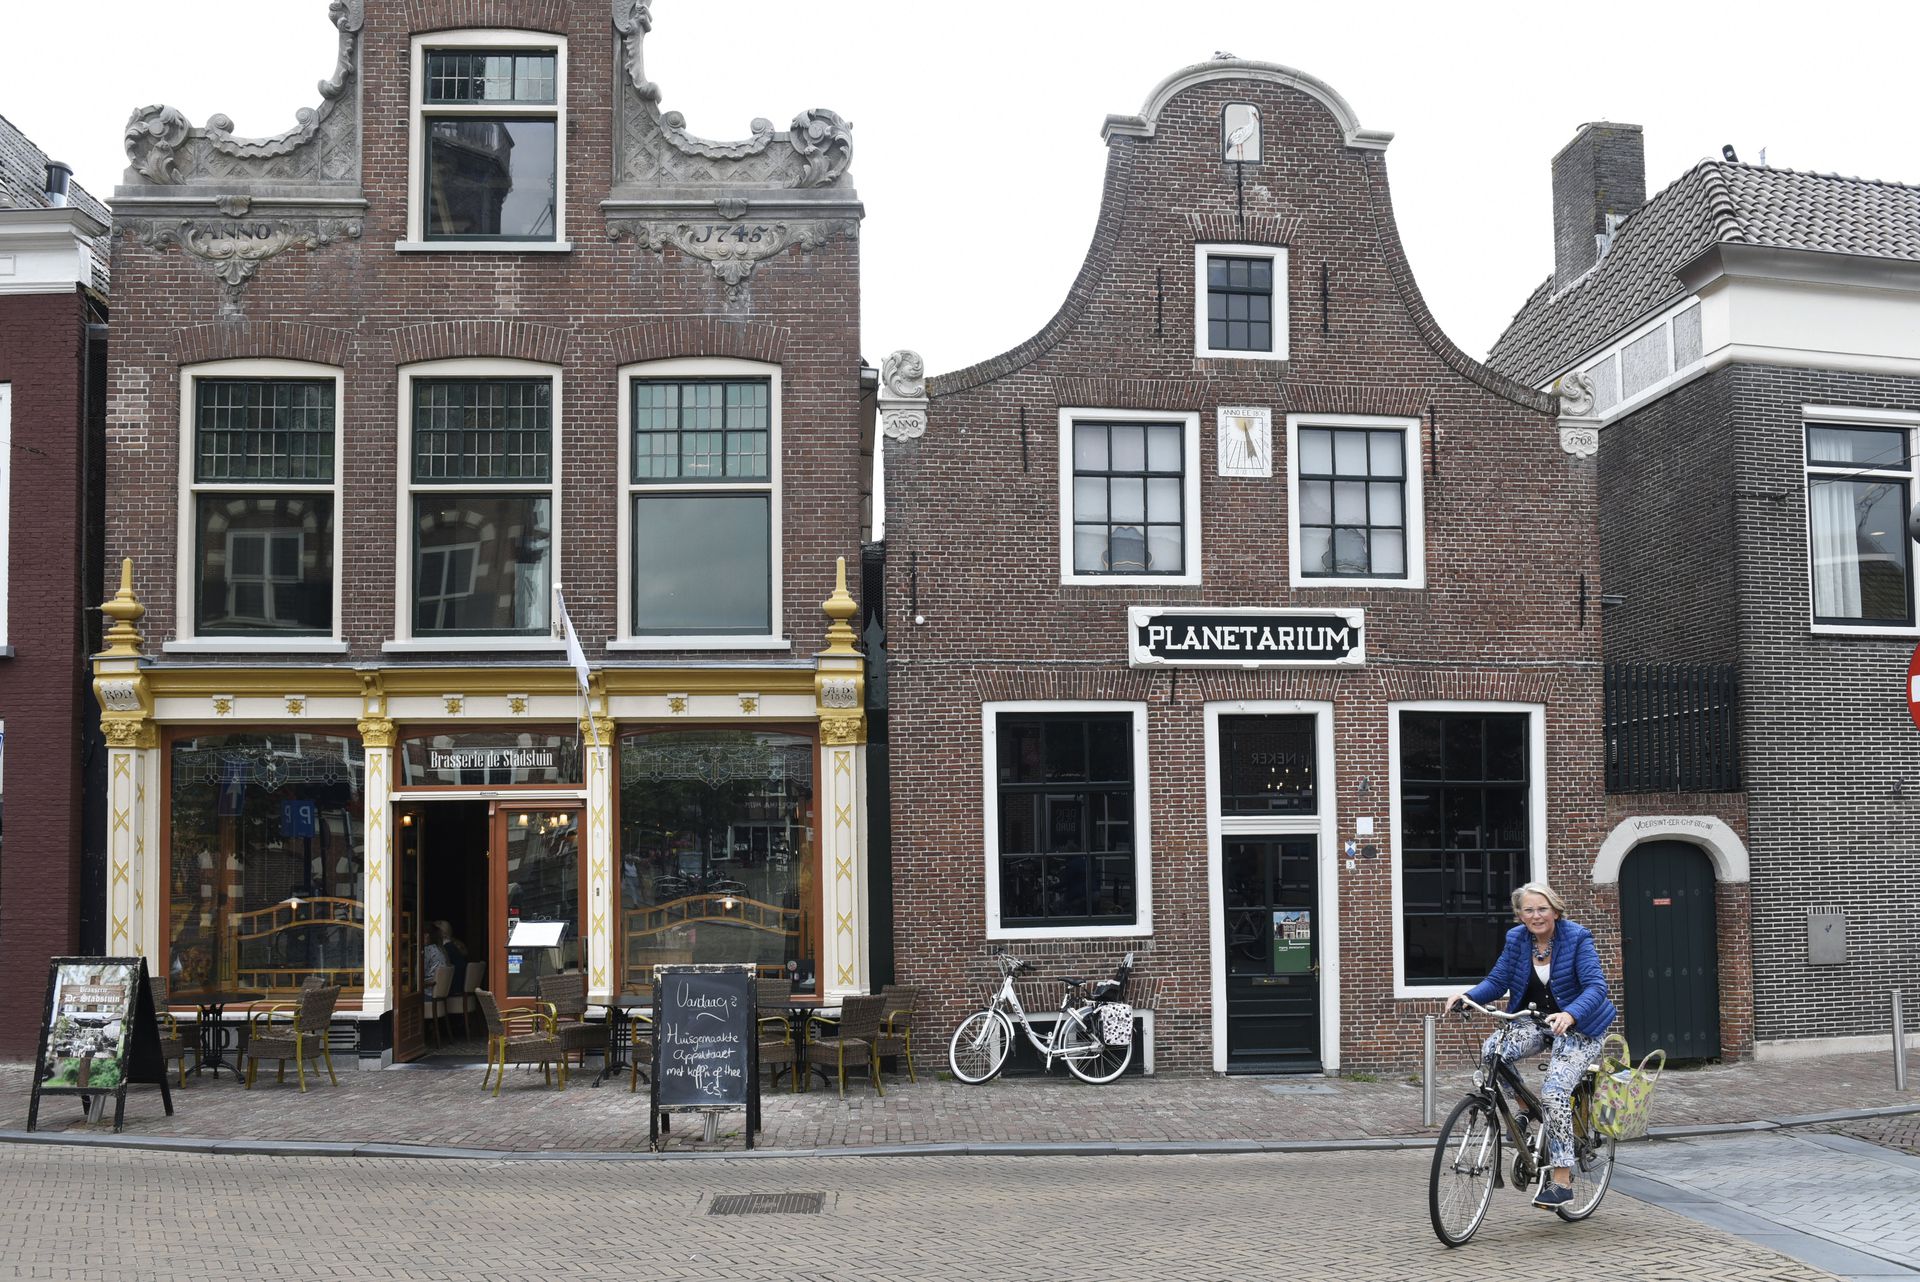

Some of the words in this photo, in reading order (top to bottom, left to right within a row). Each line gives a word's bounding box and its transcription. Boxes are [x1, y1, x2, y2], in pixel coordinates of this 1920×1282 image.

[200, 222, 272, 240] ANNO
[695, 223, 769, 243] 1745
[890, 419, 919, 428] ANNO
[1148, 626, 1350, 651] PLANETARIUM
[430, 751, 484, 769] Brasserie
[487, 750, 500, 768] de
[502, 749, 553, 768] Stadstuin
[80, 986, 108, 994] Brasserie
[666, 1022, 740, 1051] Huisgemaakte
[666, 1065, 684, 1077] met
[712, 1064, 724, 1088] of
[724, 1065, 741, 1078] thee
